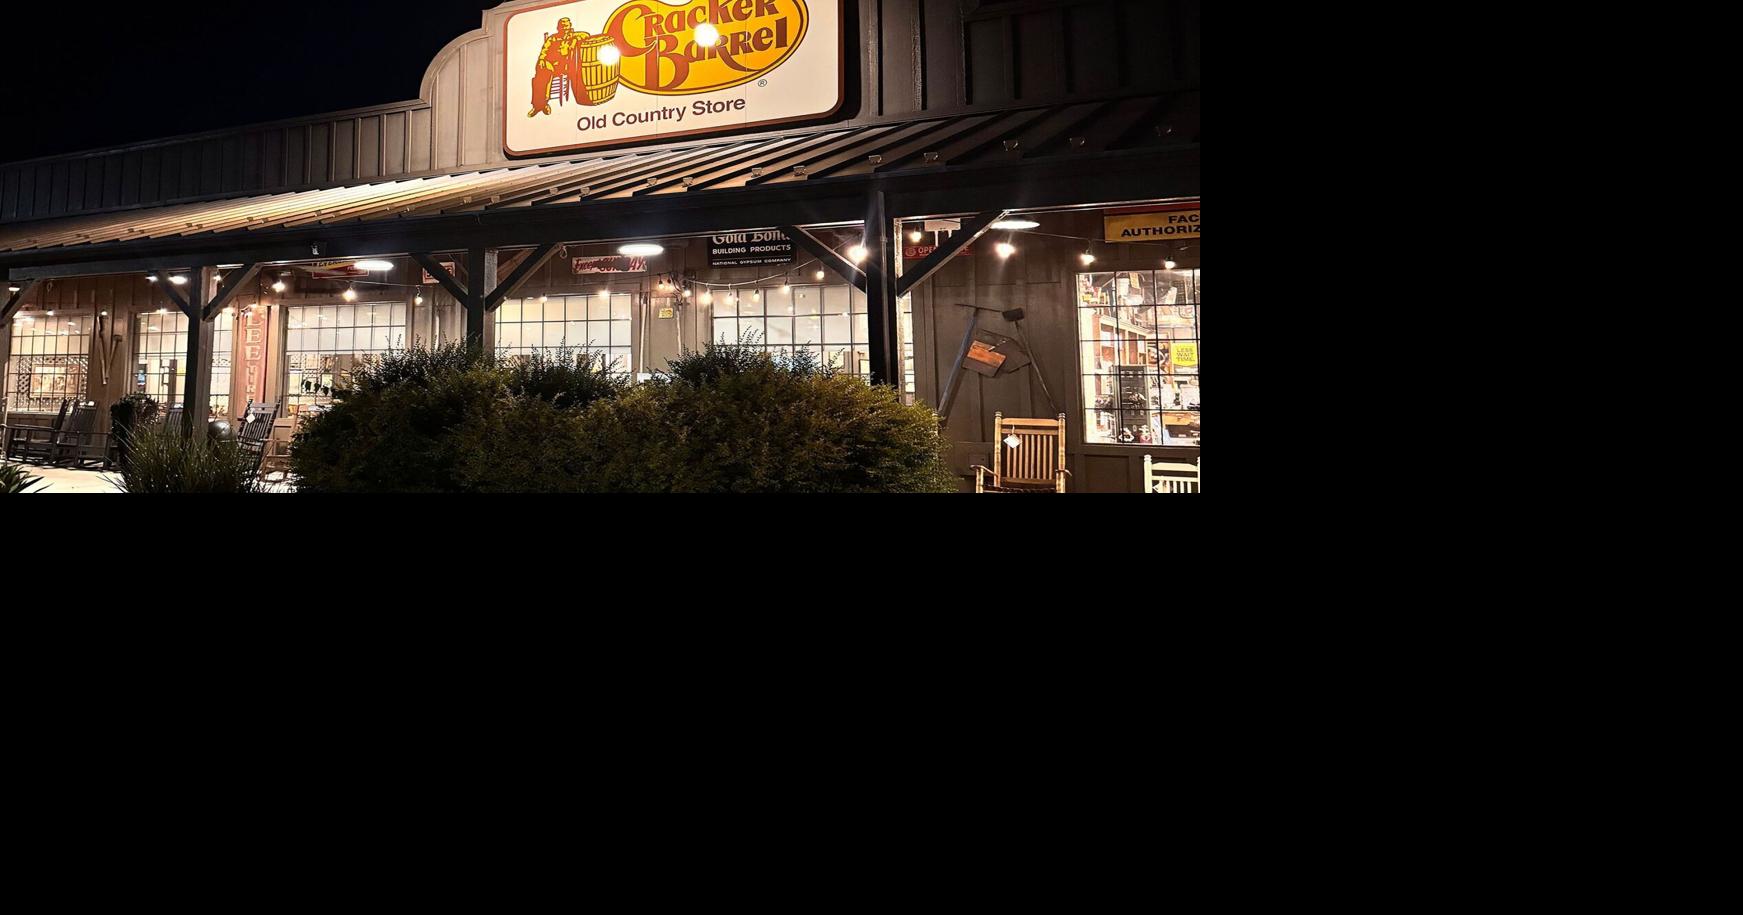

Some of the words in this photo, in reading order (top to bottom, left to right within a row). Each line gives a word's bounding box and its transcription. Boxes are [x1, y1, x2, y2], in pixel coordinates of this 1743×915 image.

[577, 114, 607, 131] Old
[612, 106, 687, 127] Country
[692, 98, 746, 116] Store
[712, 247, 747, 255] BUILDING
[750, 244, 792, 253] PRODUCTS
